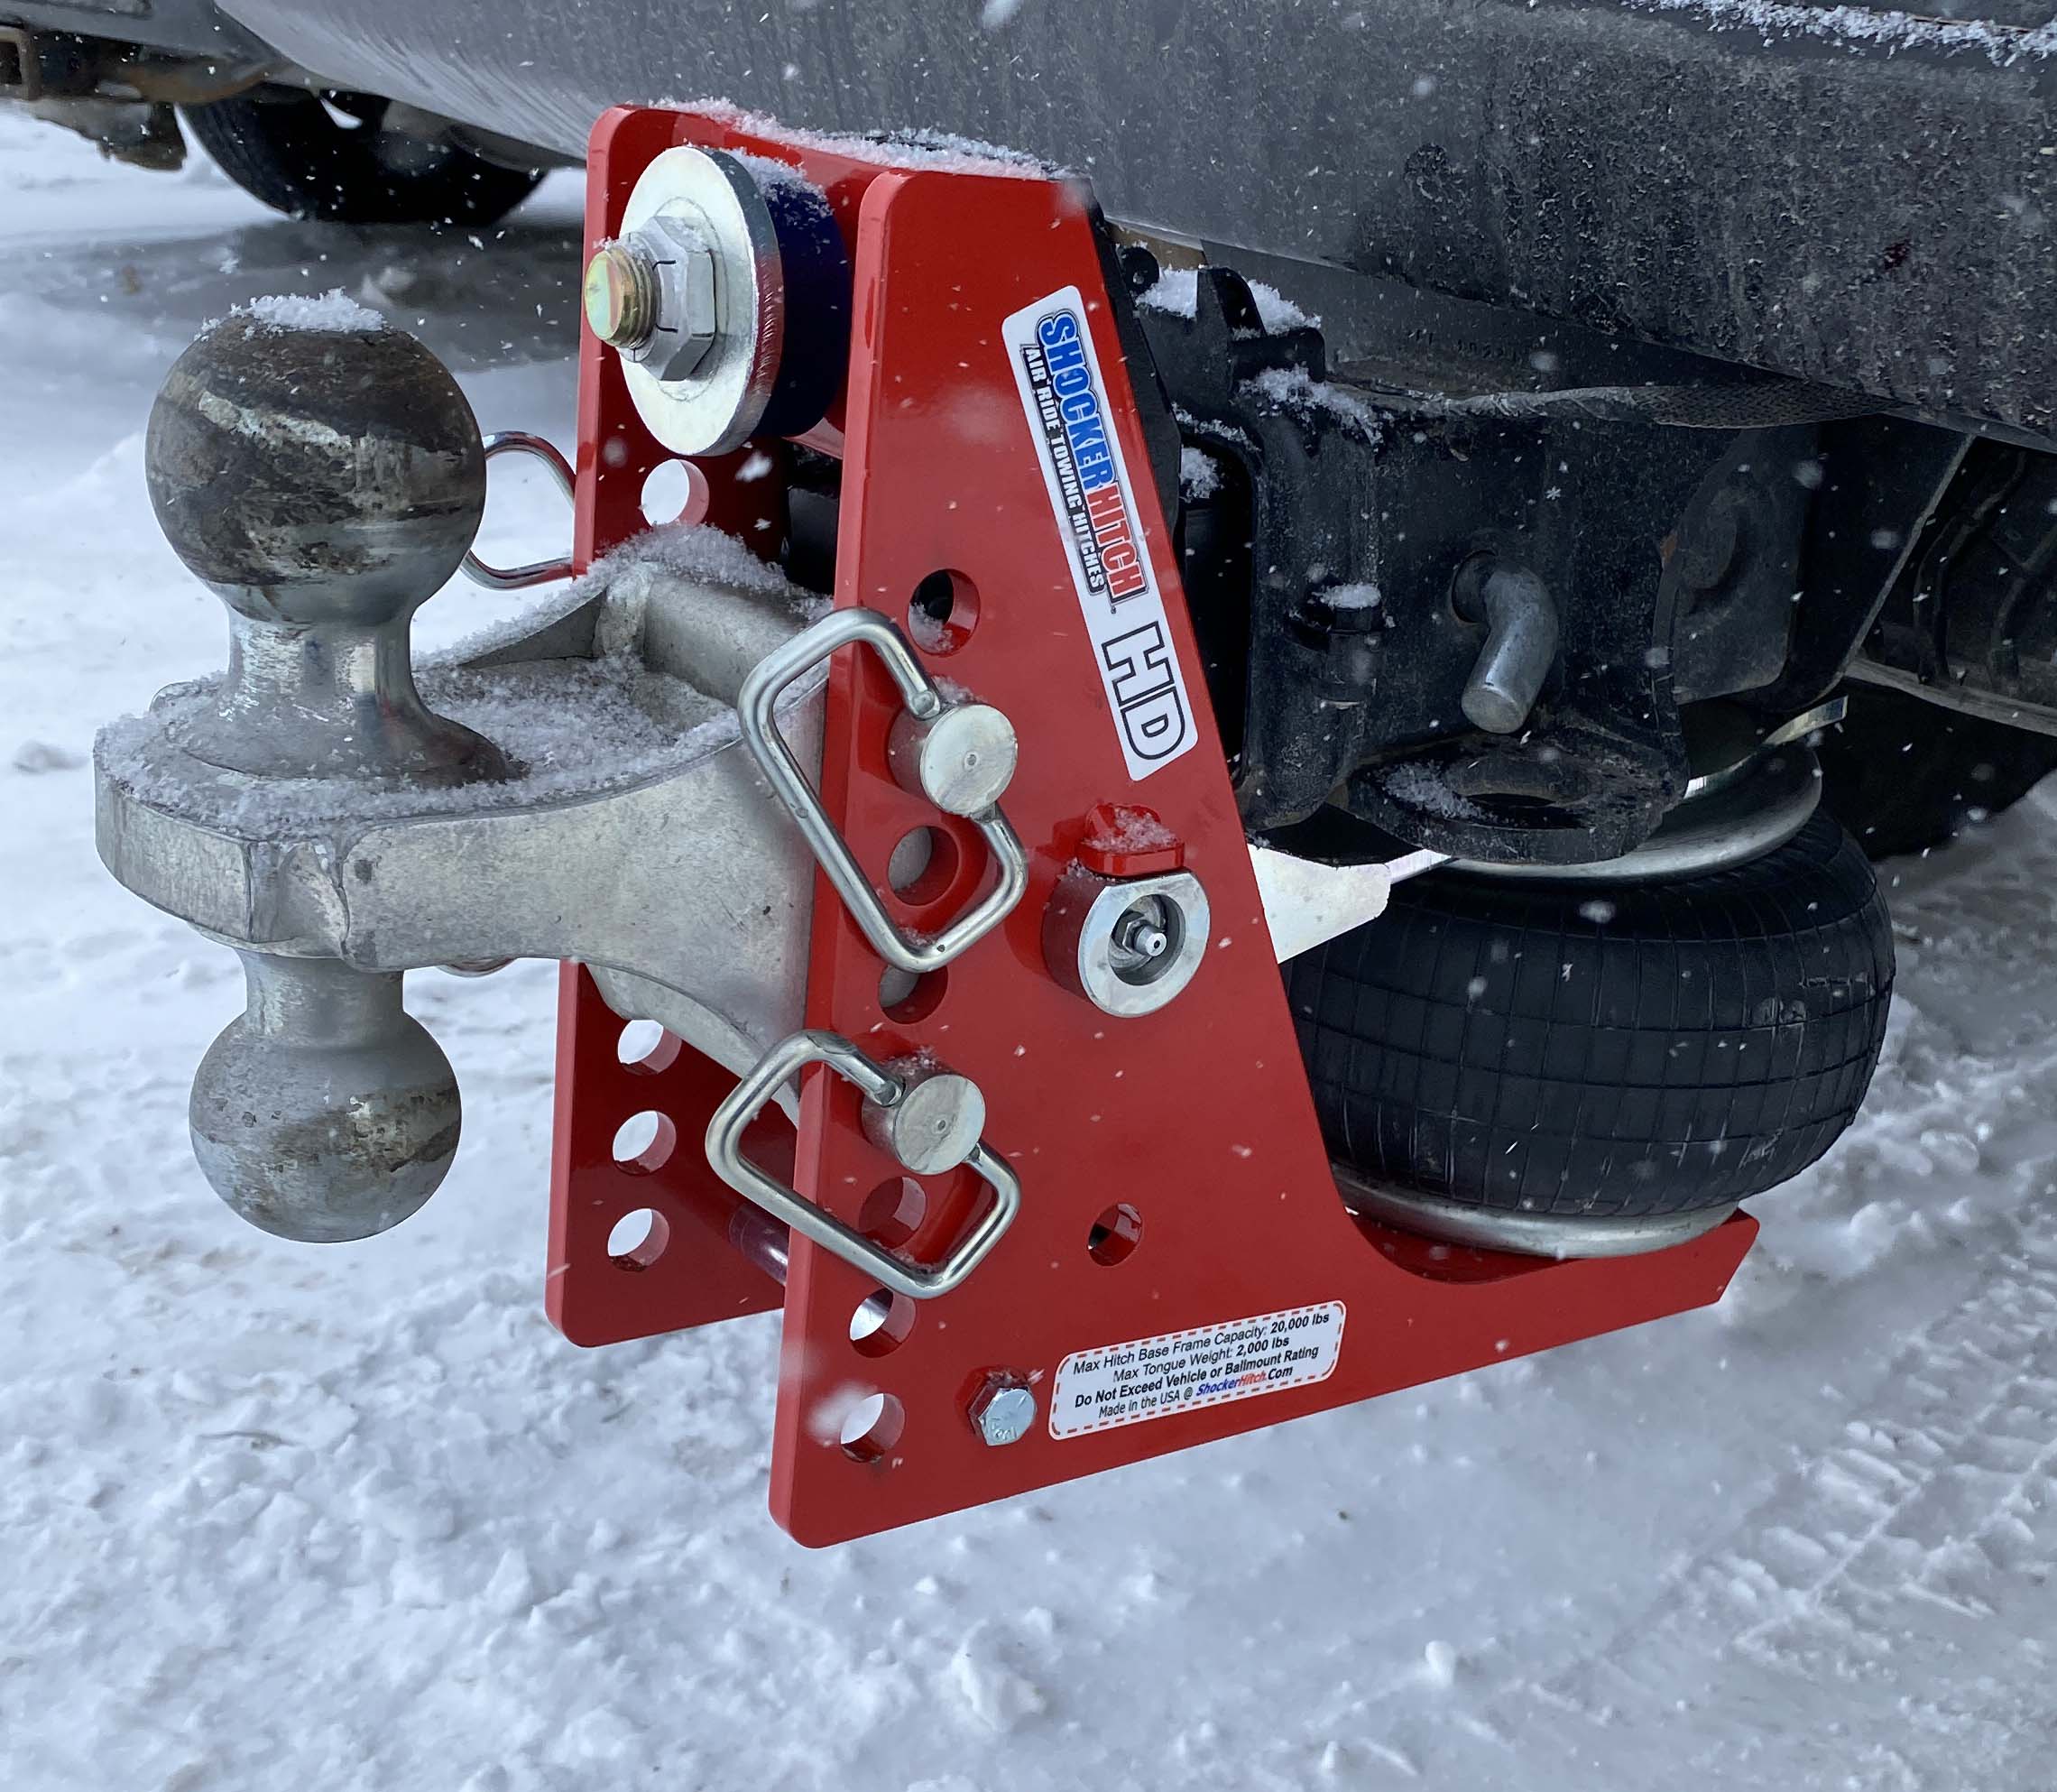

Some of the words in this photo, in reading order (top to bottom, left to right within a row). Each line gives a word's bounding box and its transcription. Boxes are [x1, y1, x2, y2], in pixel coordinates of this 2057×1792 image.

[1025, 347, 1047, 383] AIR
[1038, 385, 1060, 431] RIDE
[1049, 434, 1082, 509] TOWING
[1072, 511, 1106, 588] HITCHES
[1102, 621, 1185, 760] HD
[1074, 1360, 1101, 1374] Max
[1103, 1352, 1135, 1368] Hitch
[1138, 1346, 1169, 1361] Base
[1173, 1338, 1211, 1353] Frame
[1214, 1326, 1268, 1345] Capacity:
[1270, 1316, 1309, 1335] 20,000
[1312, 1313, 1330, 1326] lbs
[1112, 1368, 1139, 1382] Max
[1143, 1359, 1185, 1376] Tongue
[1189, 1347, 1233, 1367] Weight:
[1236, 1339, 1268, 1357] 2,000
[1271, 1336, 1290, 1349] lbs
[1075, 1394, 1092, 1408] Do
[1095, 1387, 1117, 1403] Not
[1120, 1375, 1163, 1398] Exceed
[1167, 1369, 1207, 1388] Vehicle
[1210, 1366, 1222, 1378] or
[1225, 1353, 1281, 1375] Ballmount
[1284, 1345, 1319, 1362] Rating
[1099, 1401, 1126, 1418] Made
[1128, 1399, 1139, 1412] in
[1140, 1395, 1158, 1409] the
[1160, 1390, 1180, 1405] USA
[1195, 1366, 1293, 1397] ShockerHitch.Com
